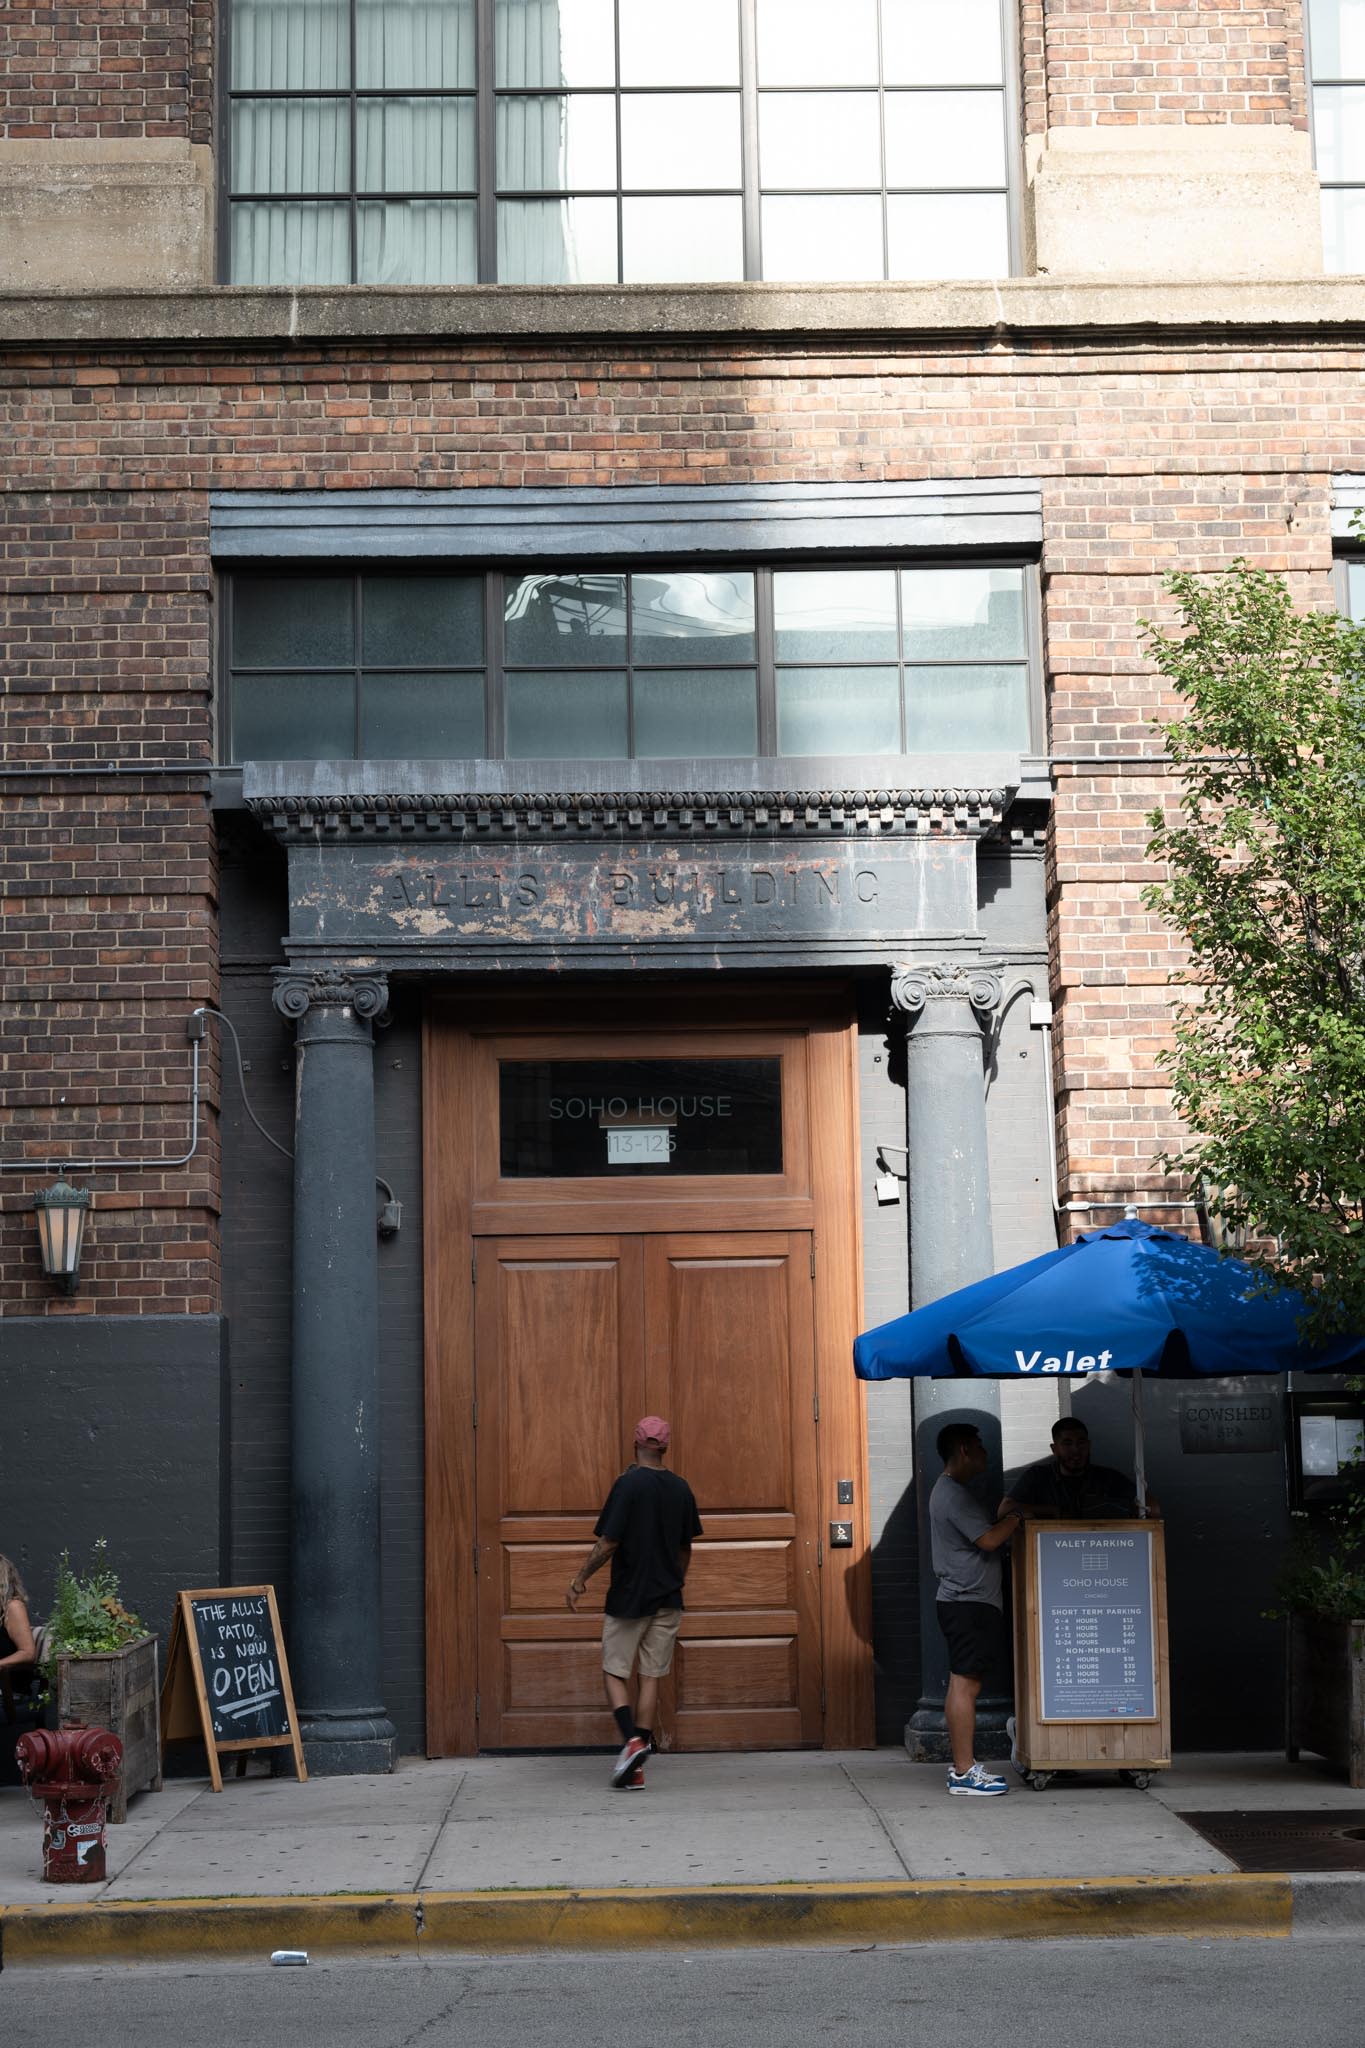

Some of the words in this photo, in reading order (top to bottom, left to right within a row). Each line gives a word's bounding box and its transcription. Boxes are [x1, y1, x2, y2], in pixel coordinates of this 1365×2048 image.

[391, 873, 539, 908] ALLIS
[608, 870, 880, 906] BUILDING
[549, 1097, 629, 1119] SOHO
[638, 1096, 733, 1118] HOUSE
[605, 1134, 677, 1153] 113-125
[1015, 1349, 1113, 1372] Valet
[1186, 1407, 1273, 1422] COWSHED
[1055, 1540, 1087, 1548] VALET
[1089, 1539, 1135, 1548] PARKING
[1063, 1578, 1092, 1588] SOHO
[1094, 1578, 1129, 1587] HOUSE
[196, 1604, 226, 1620] THE
[231, 1600, 264, 1618] ALLIS
[218, 1624, 255, 1640] PATIO
[210, 1646, 226, 1659] IS
[235, 1640, 267, 1658] NOW
[213, 1659, 275, 1697] OPEN
